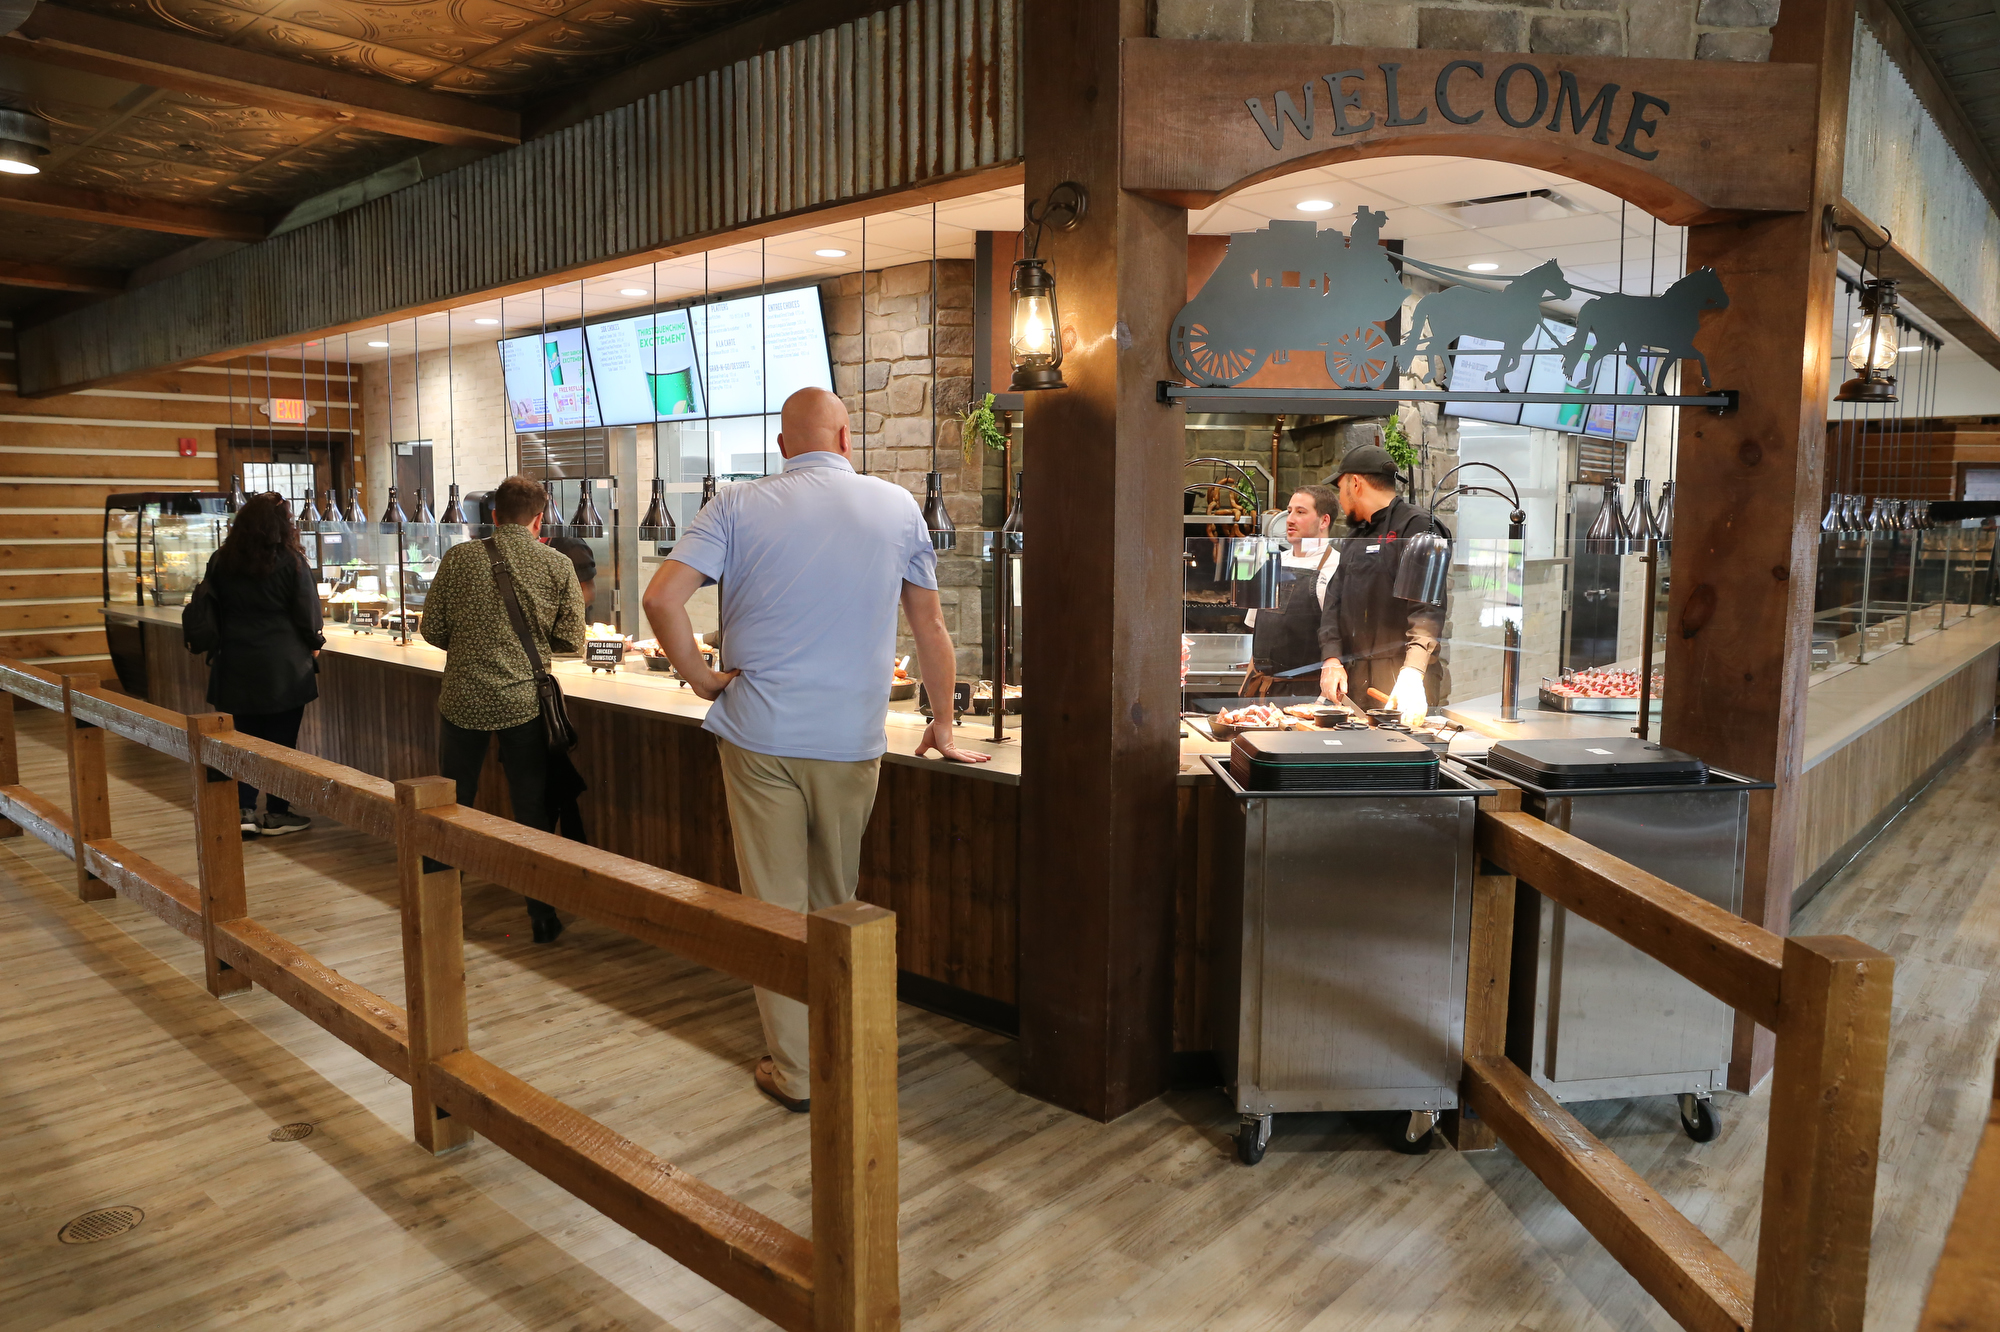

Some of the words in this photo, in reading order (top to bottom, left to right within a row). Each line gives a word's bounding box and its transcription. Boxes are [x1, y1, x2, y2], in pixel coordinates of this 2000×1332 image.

[1244, 59, 1670, 161] WELCOME
[768, 302, 783, 313] ENTREE
[783, 300, 800, 310] CHOICES
[637, 327, 654, 337] THIRST
[655, 322, 686, 334] QUENCHING
[639, 332, 686, 348] EXCTEMENT
[276, 399, 303, 419] EXIT
